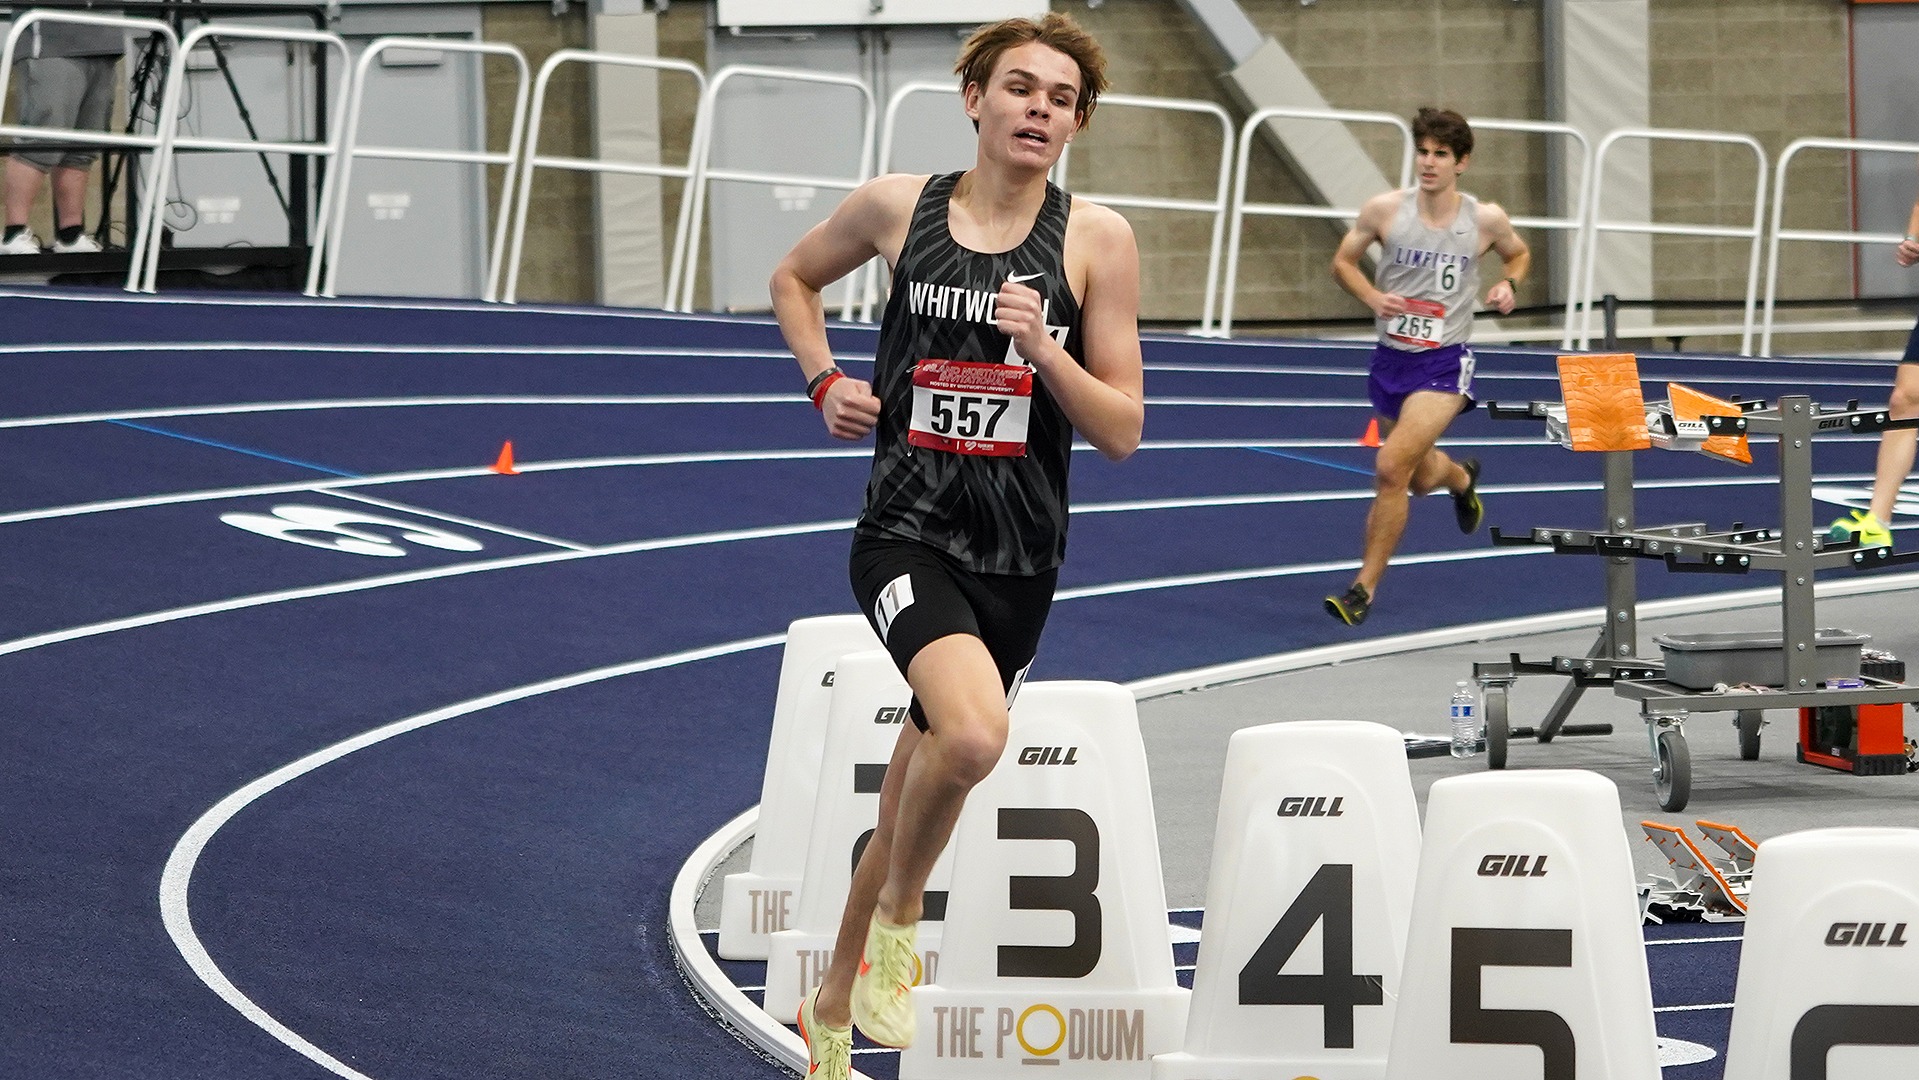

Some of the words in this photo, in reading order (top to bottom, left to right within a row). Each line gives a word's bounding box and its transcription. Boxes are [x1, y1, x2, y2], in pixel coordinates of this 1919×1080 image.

[1441, 264, 1454, 291] 6
[1396, 314, 1433, 339] 265
[930, 393, 1010, 438] 557
[1818, 418, 1845, 429] GILL
[877, 582, 900, 628] 11
[1017, 746, 1079, 766] GILL
[1276, 796, 1345, 817] GILL
[1476, 855, 1549, 877] GILL
[997, 807, 1102, 978] 3
[748, 890, 792, 934] THE
[1823, 922, 1909, 947] GILL
[1238, 863, 1384, 1049] 4
[1450, 927, 1576, 1080] 5
[933, 1006, 984, 1058] THE
[996, 1003, 1145, 1062] PODIUM
